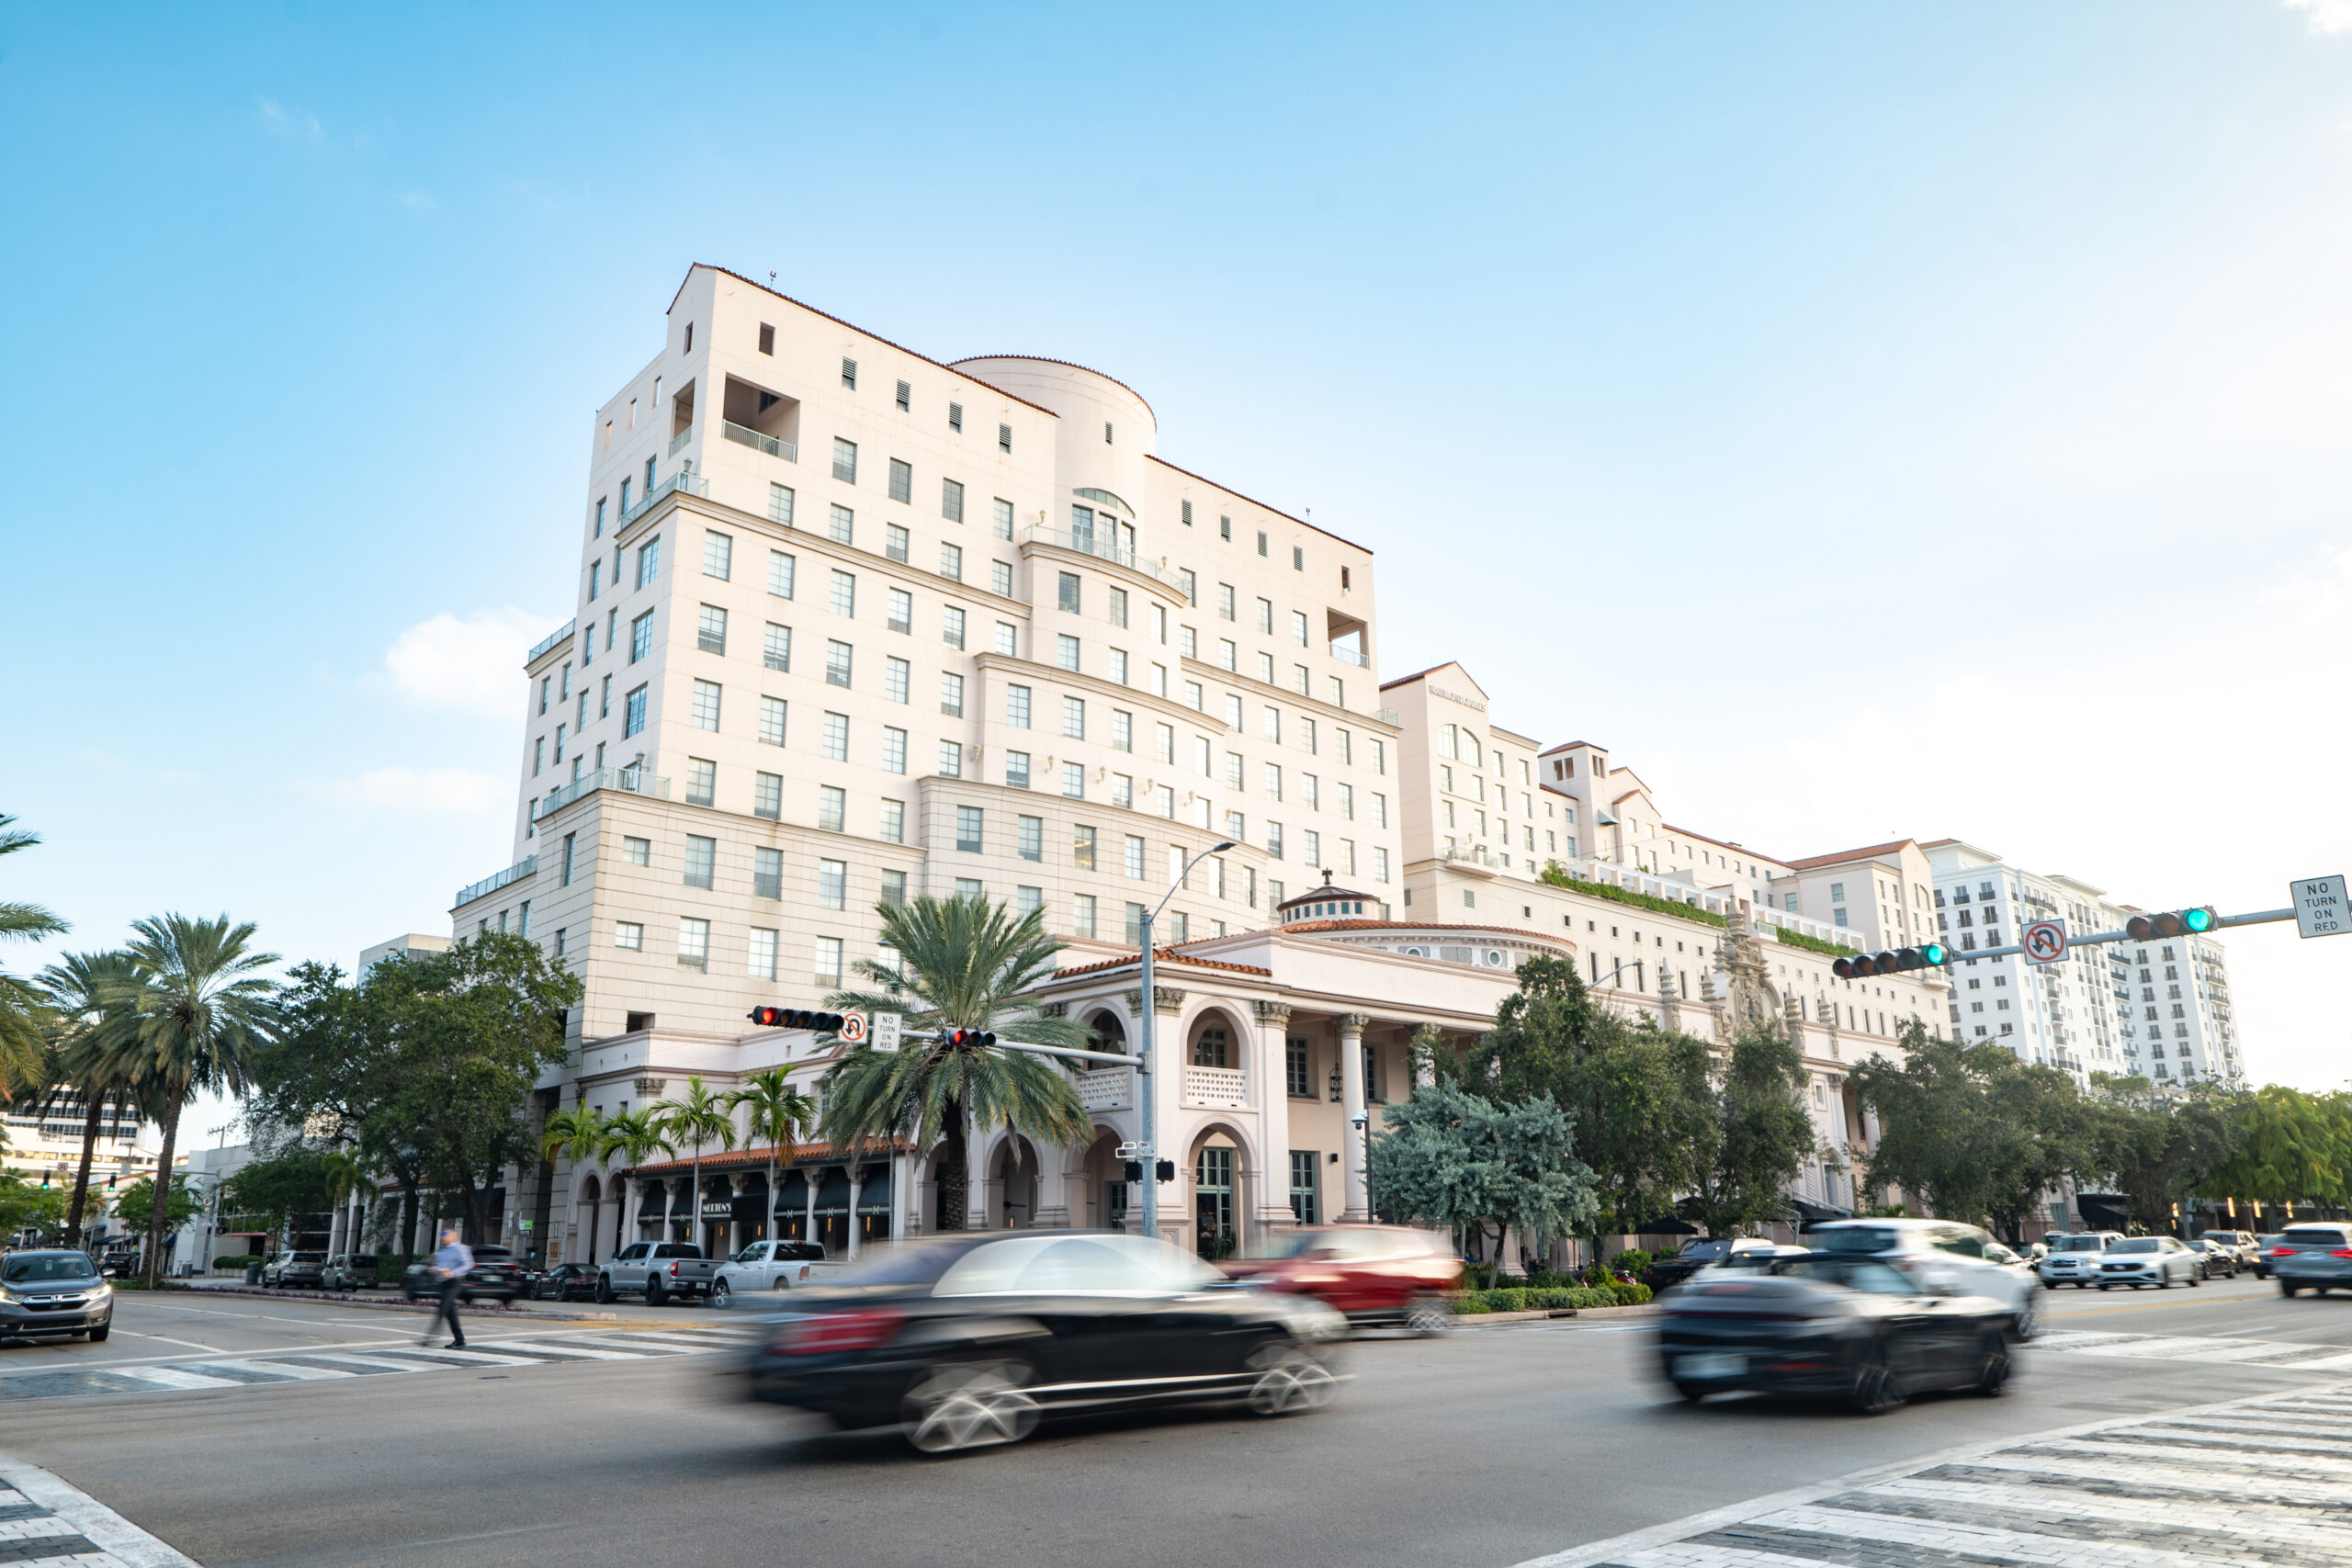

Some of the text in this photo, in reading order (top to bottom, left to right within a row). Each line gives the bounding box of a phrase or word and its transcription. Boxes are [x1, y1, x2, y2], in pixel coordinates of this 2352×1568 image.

[2307, 882, 2328, 896] NO
[2304, 896, 2336, 908] TURN
[2314, 908, 2333, 919] ON
[2314, 920, 2338, 932] RED
[882, 1015, 894, 1024] NO
[879, 1025, 896, 1033] TURN
